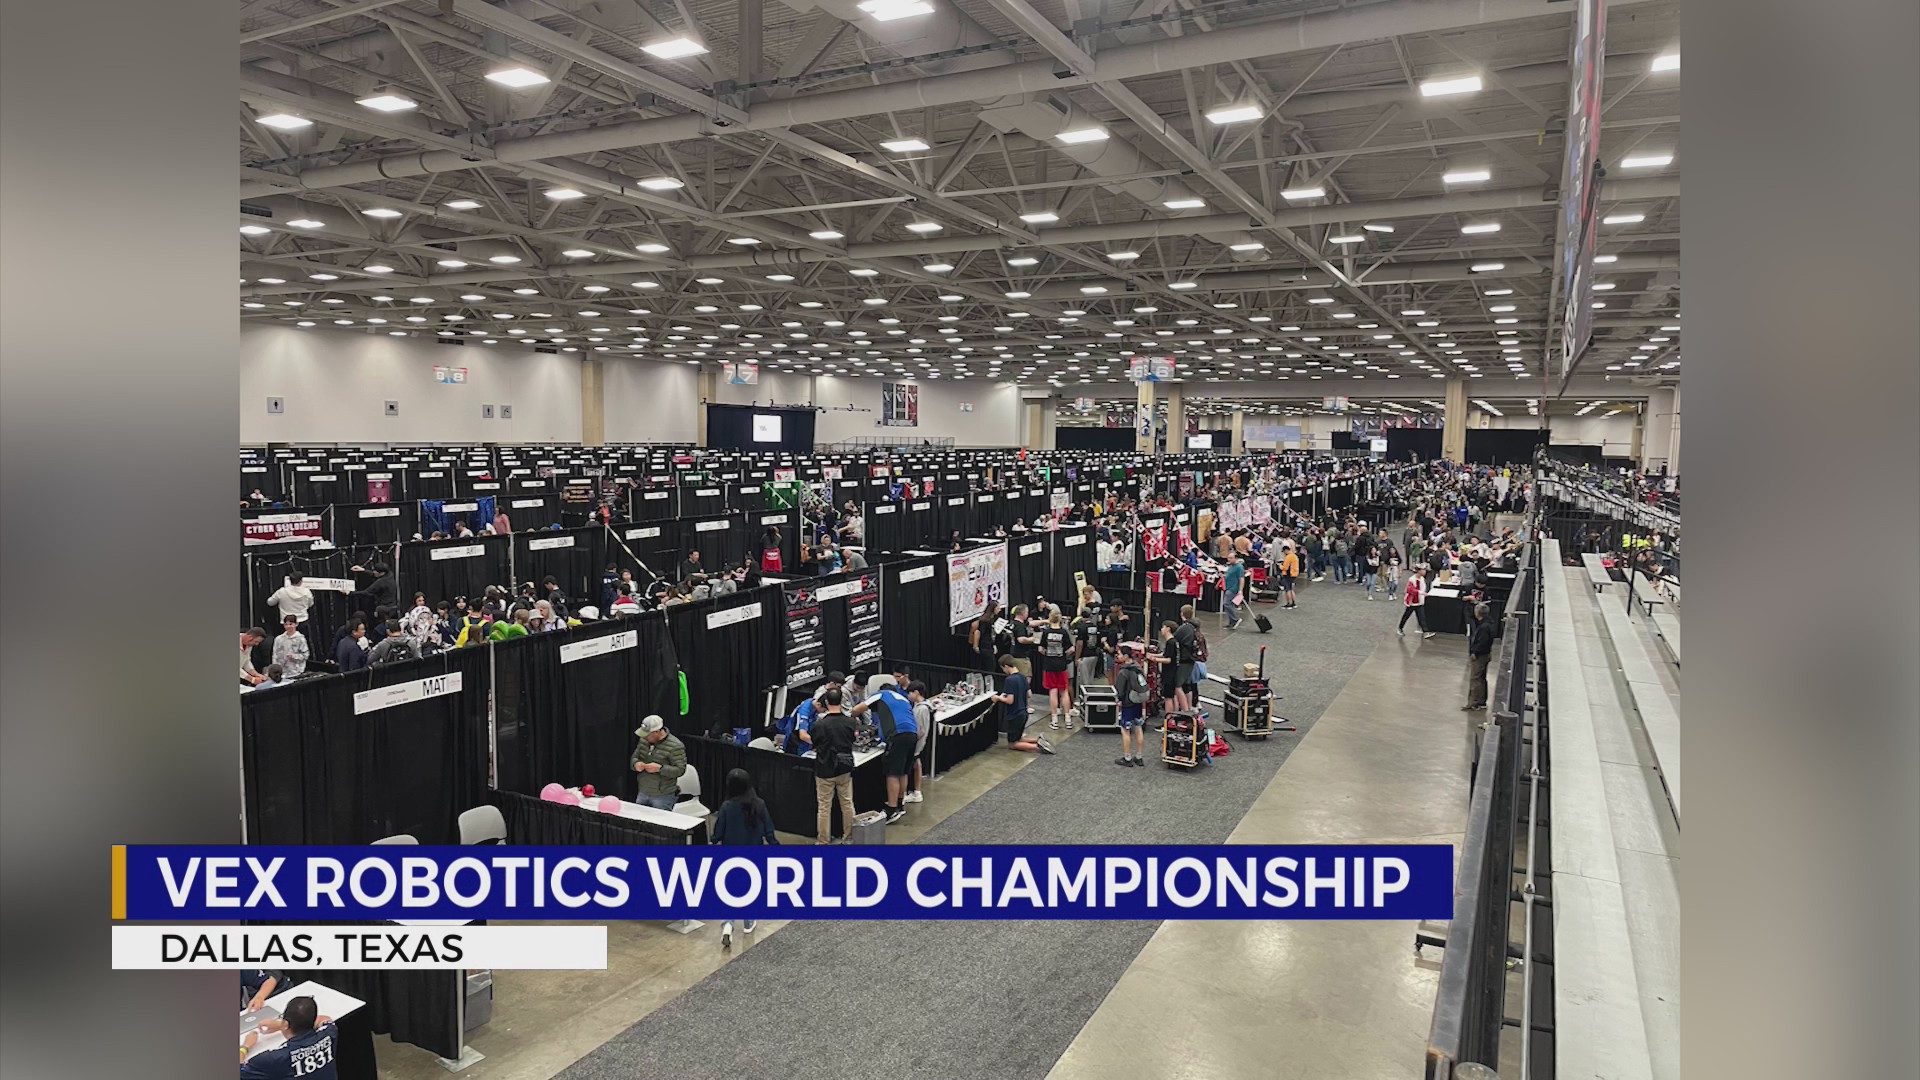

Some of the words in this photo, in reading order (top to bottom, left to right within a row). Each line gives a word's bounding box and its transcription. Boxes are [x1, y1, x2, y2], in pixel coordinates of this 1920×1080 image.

[246, 524, 274, 535] CYBER
[786, 587, 817, 605] VEX
[611, 633, 626, 650] ART
[422, 677, 447, 697] MAT
[291, 1046, 335, 1077] 1831
